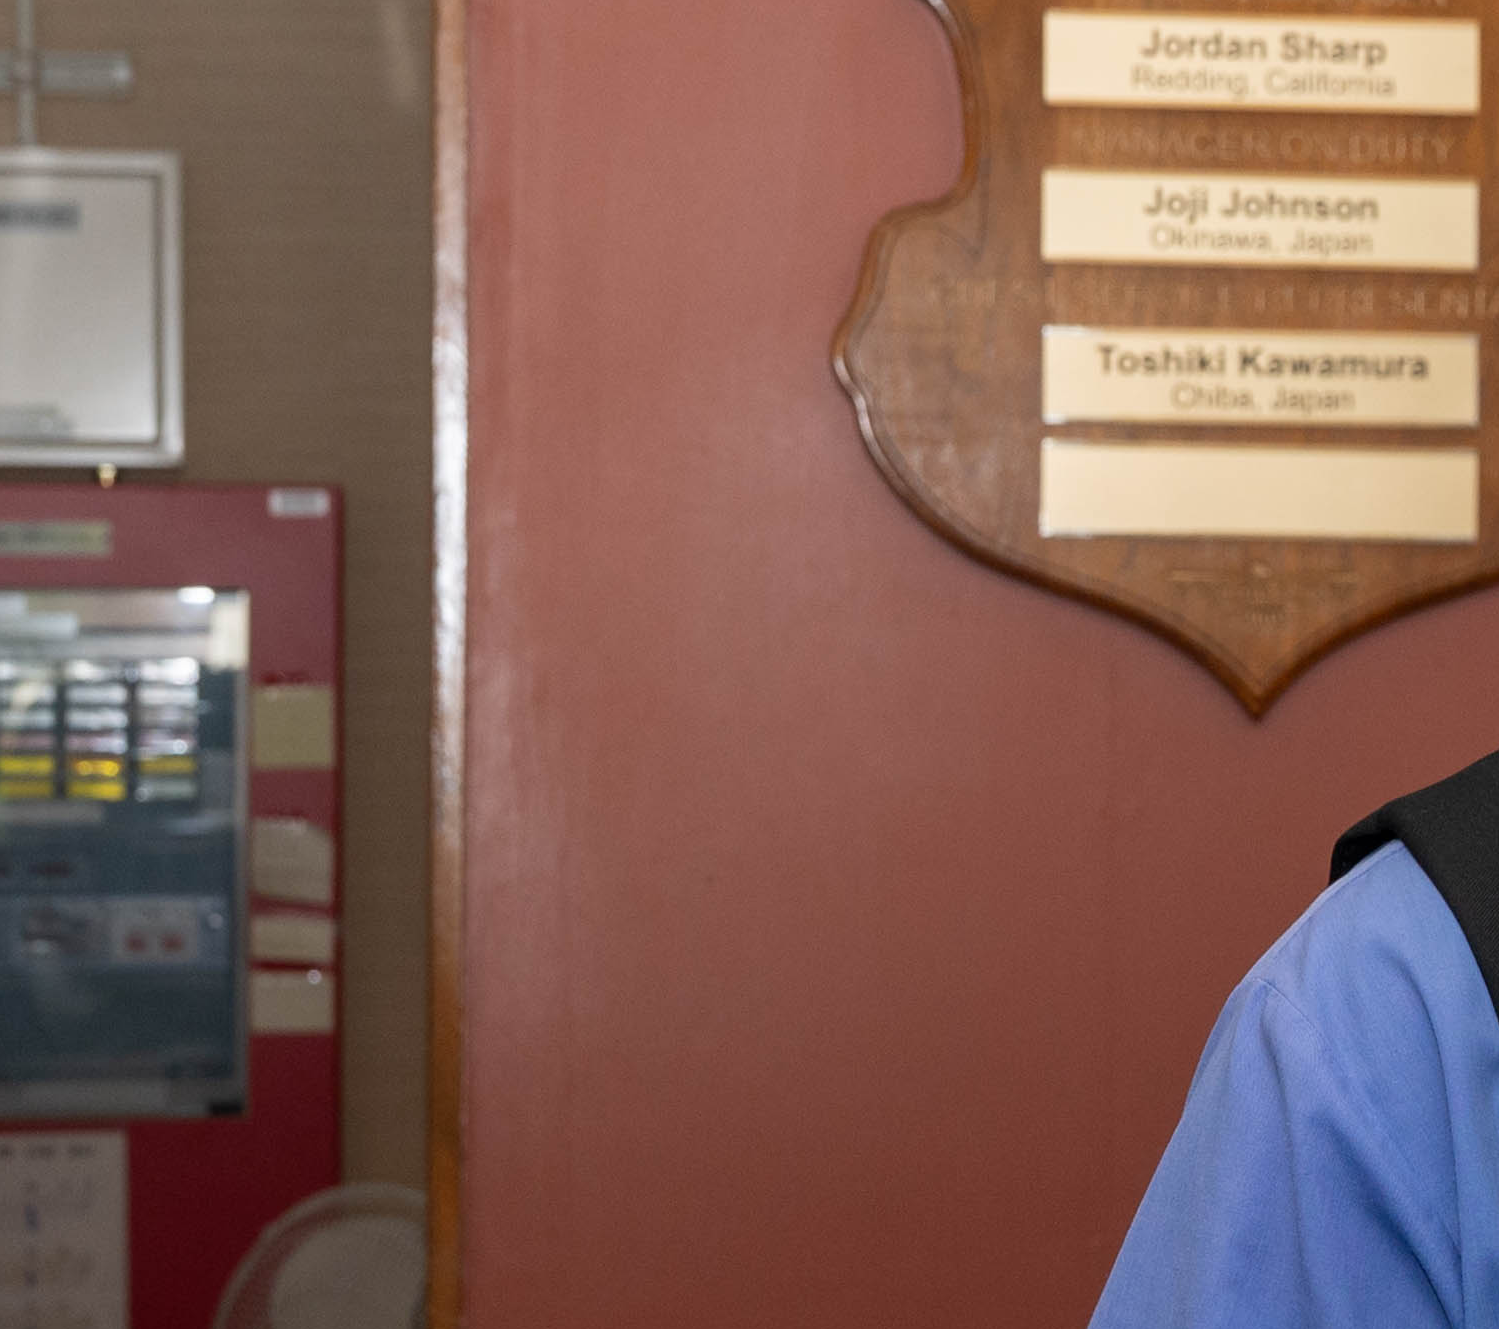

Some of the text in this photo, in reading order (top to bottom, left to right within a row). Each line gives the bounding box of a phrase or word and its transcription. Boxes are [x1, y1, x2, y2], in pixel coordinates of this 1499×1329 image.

[1140, 28, 1389, 68] Jordan Sharp
[1263, 67, 1397, 98] California
[1349, 132, 1460, 166] DUTY
[1142, 185, 1381, 223] Joji Johnson
[1288, 228, 1374, 260] Japan
[1095, 342, 1432, 383] Toshiki Kawamura
[1269, 384, 1357, 417] Japan
